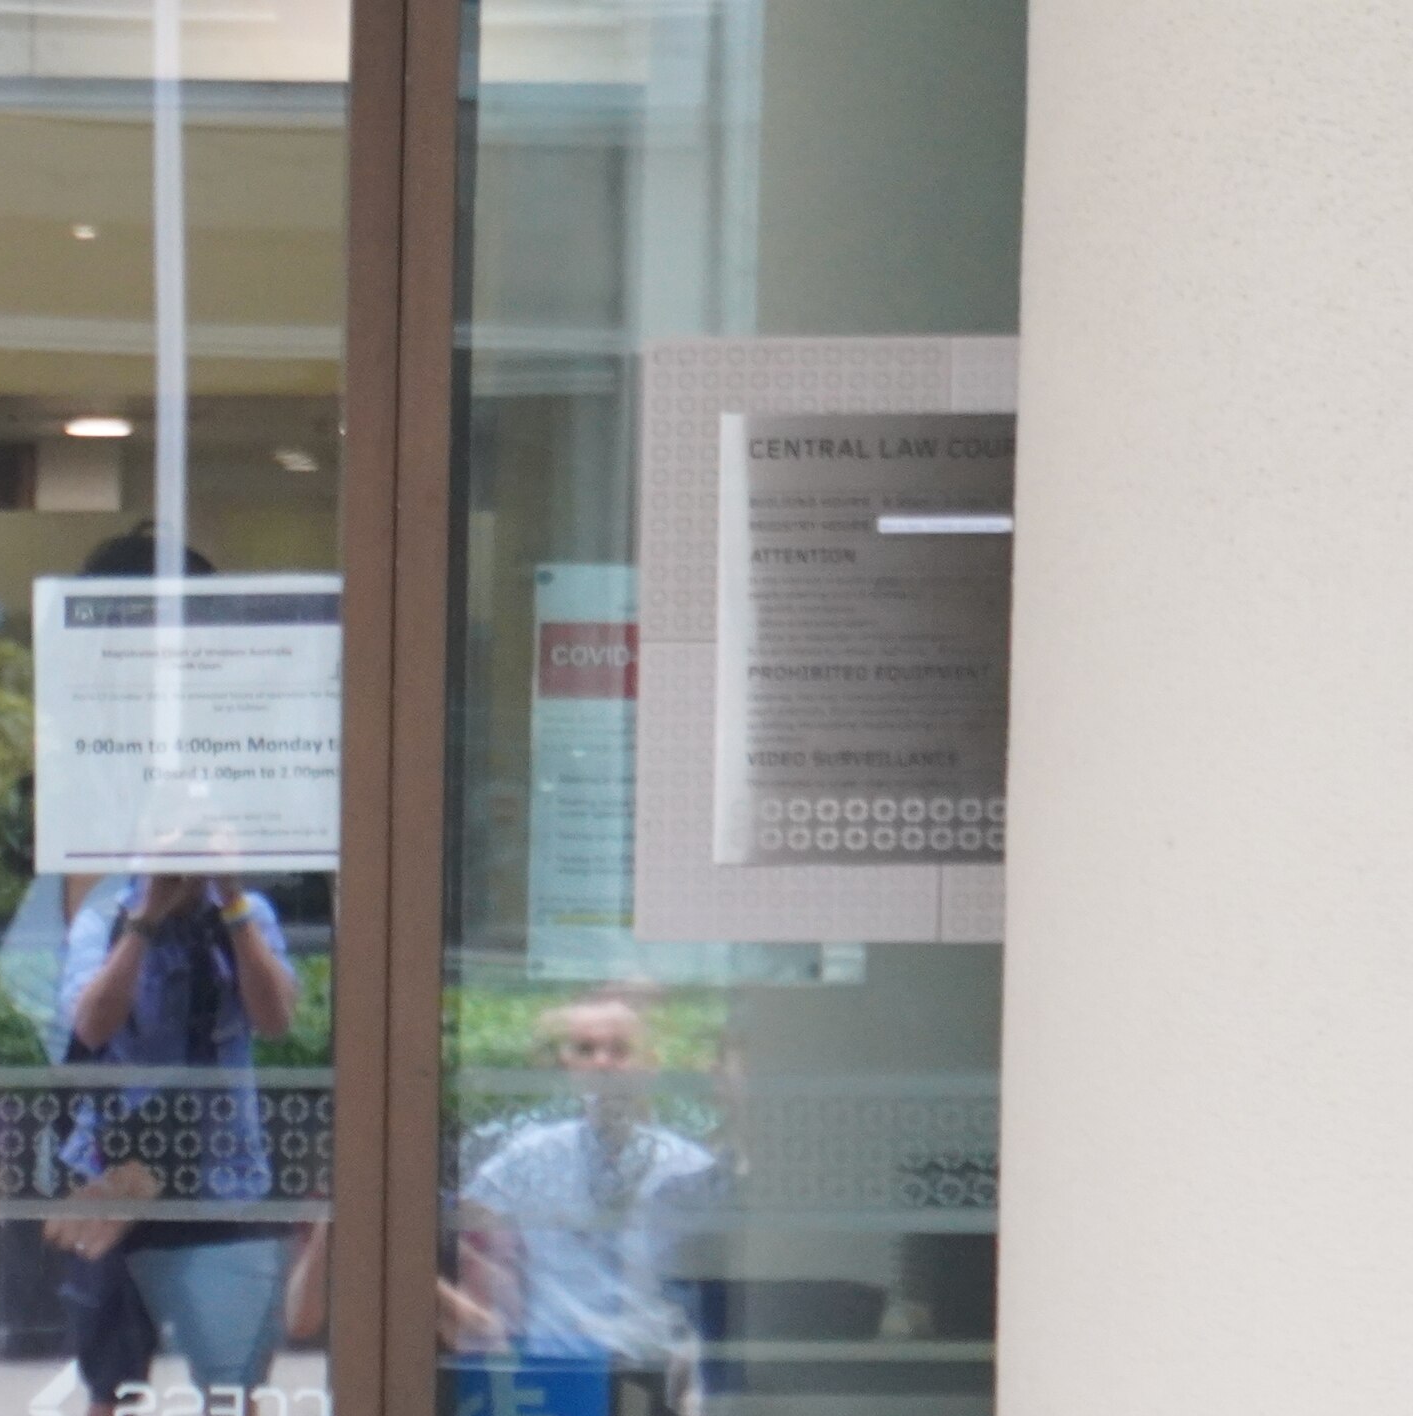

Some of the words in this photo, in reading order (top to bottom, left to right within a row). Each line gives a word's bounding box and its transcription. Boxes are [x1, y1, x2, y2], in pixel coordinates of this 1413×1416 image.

[749, 437, 871, 460] CENTRAL
[878, 437, 936, 460] LAW
[752, 546, 857, 564] ATTENTION
[75, 737, 143, 755] 9:00am
[247, 735, 324, 757] Monday
